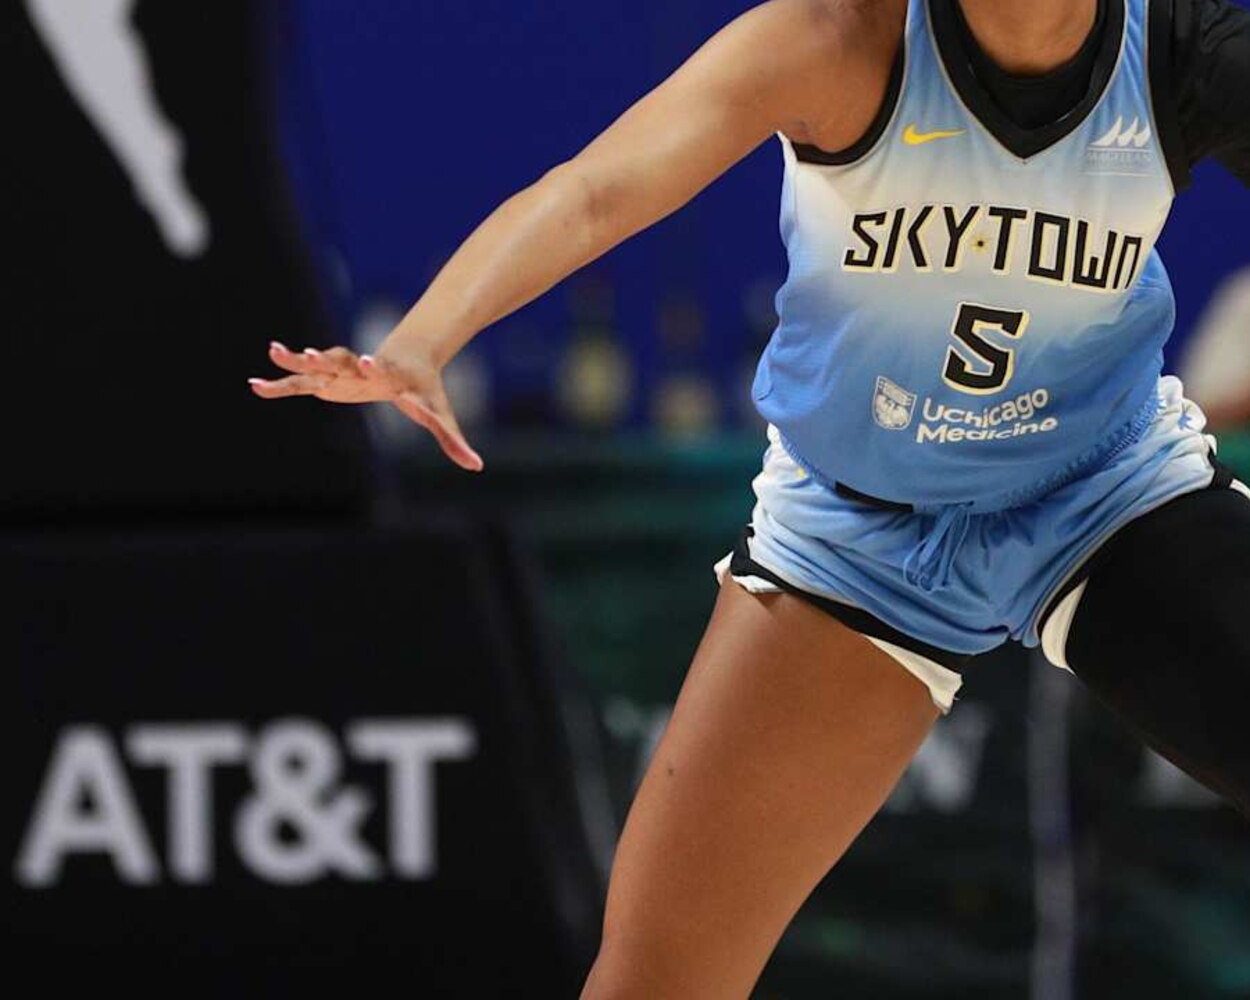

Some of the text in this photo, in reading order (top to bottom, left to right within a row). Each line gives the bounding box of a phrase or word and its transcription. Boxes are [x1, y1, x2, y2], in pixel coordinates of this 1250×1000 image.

[943, 302, 1027, 392] 5
[915, 416, 1059, 444] Medicine
[15, 717, 475, 886] AT&T
